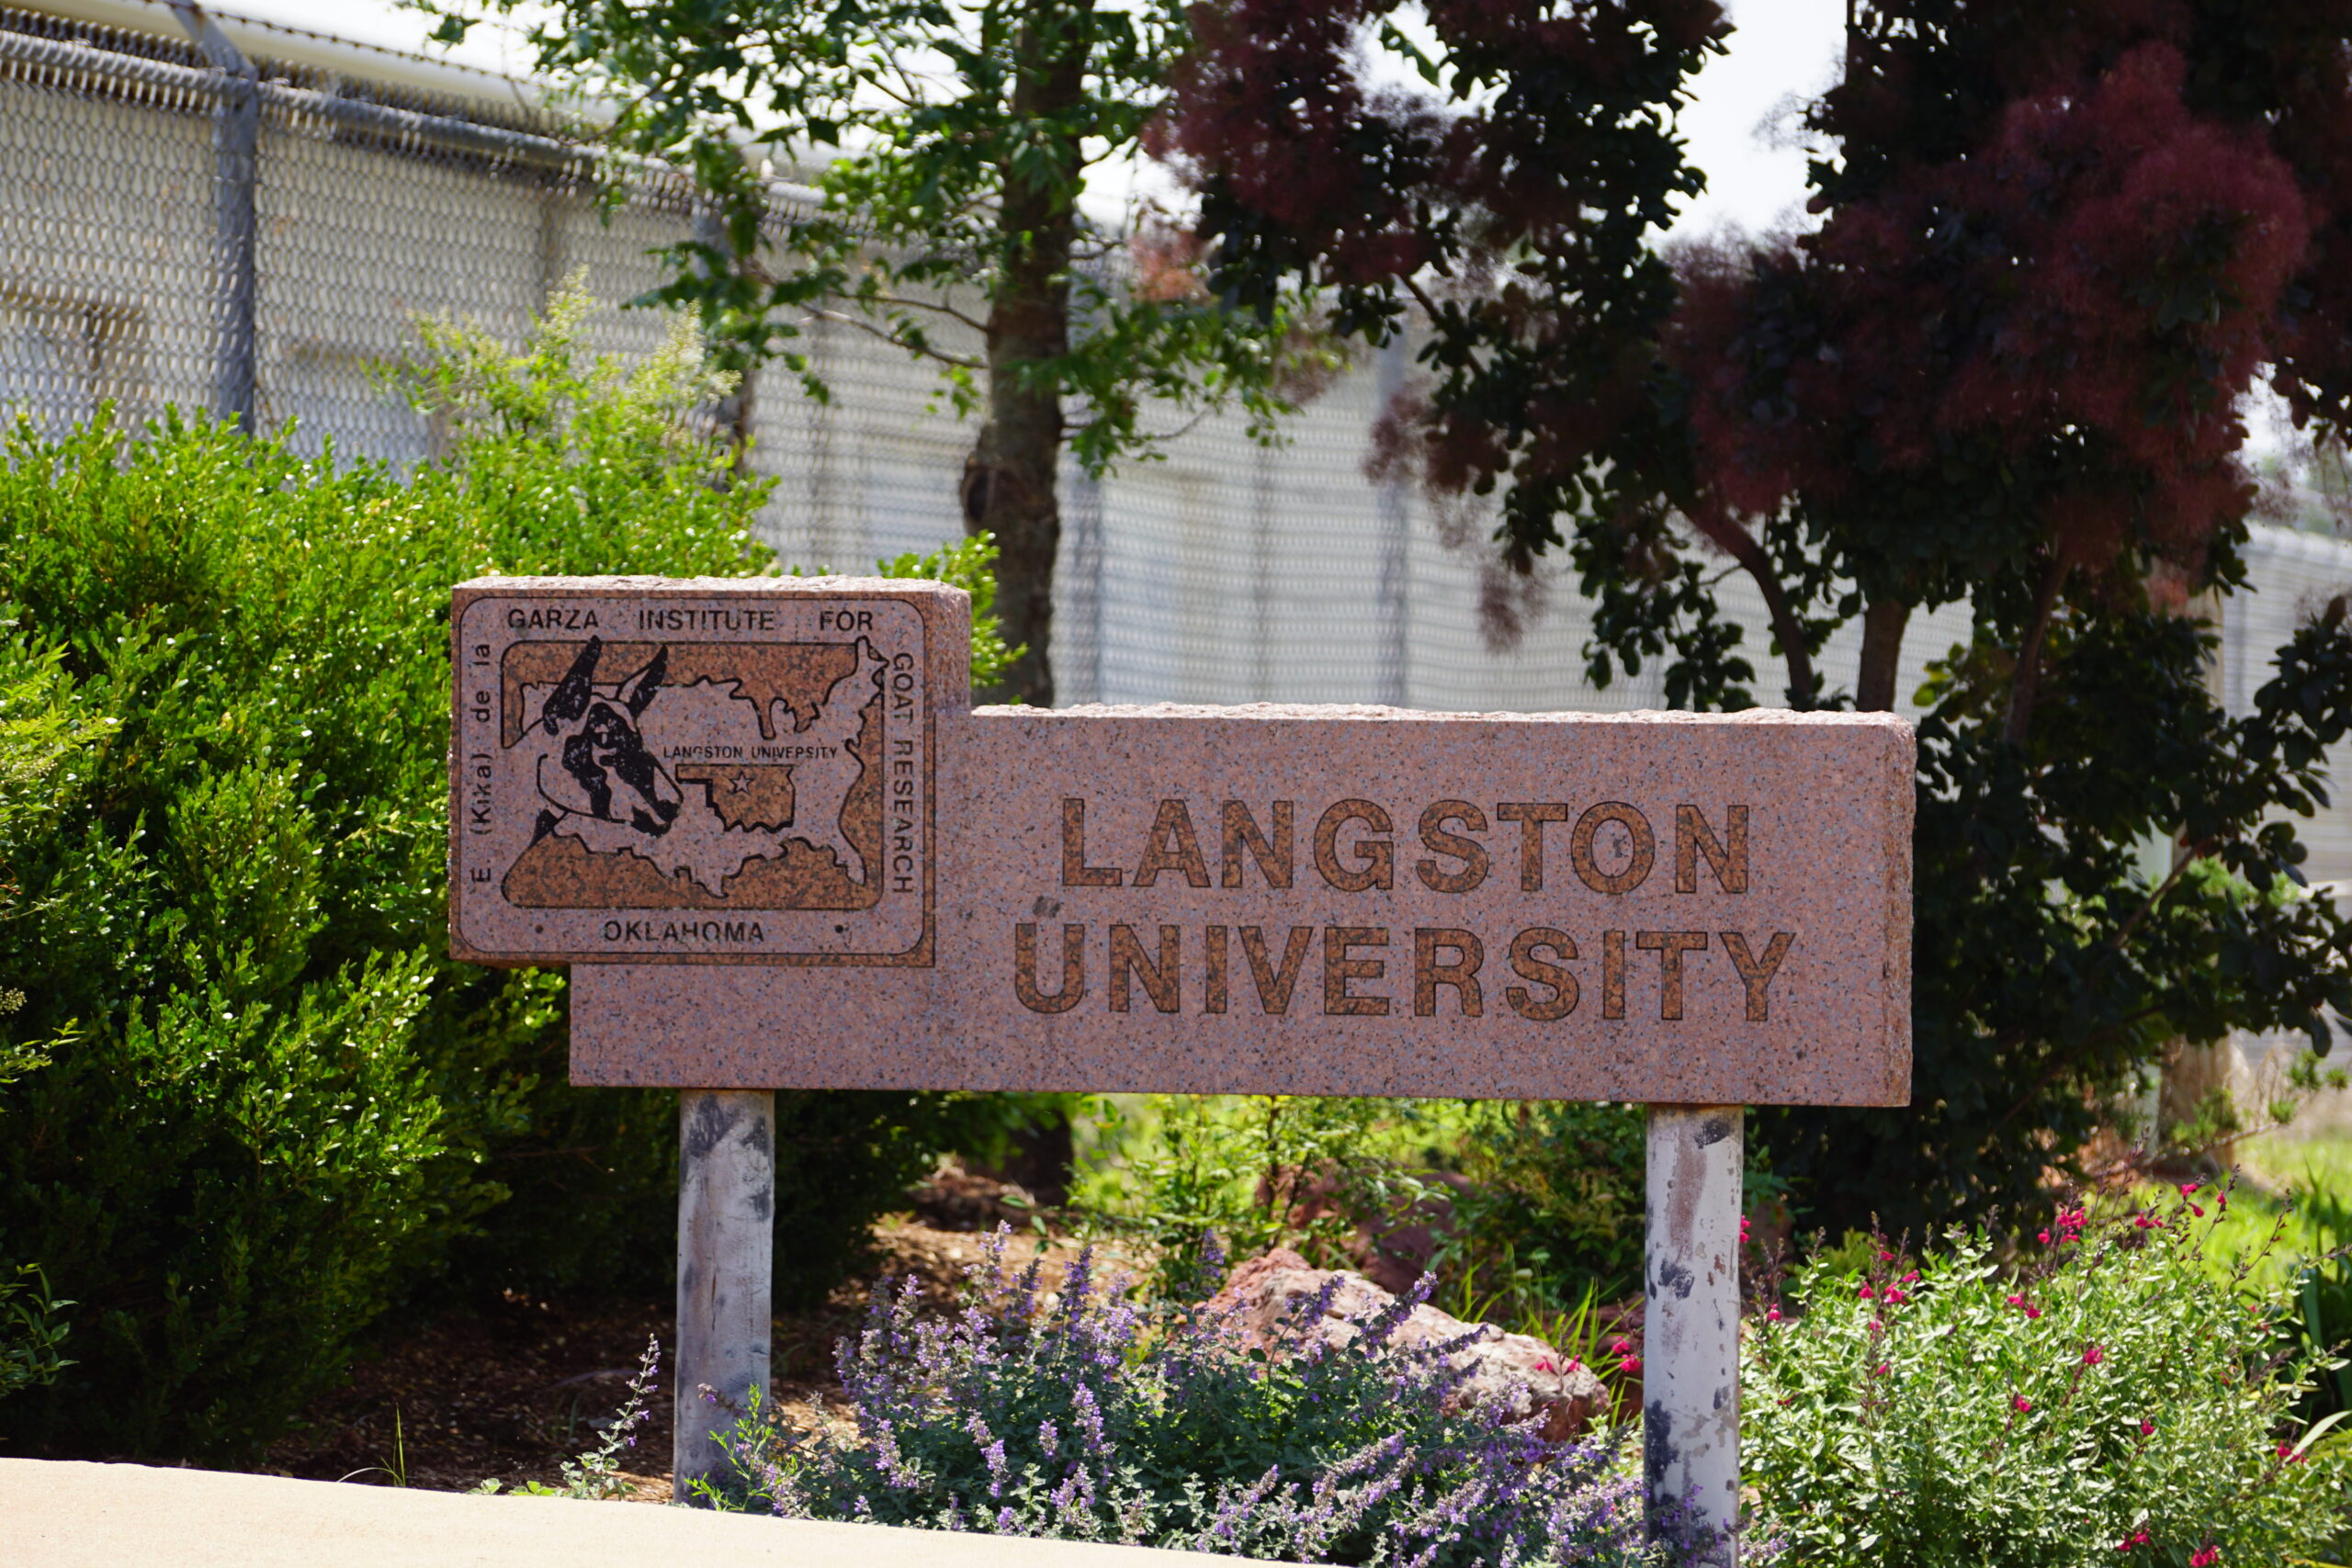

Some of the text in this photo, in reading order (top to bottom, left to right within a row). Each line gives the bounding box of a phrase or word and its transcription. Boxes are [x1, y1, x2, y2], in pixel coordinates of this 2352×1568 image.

[507, 609, 873, 632] GARZA INSTITUTE FOR
[471, 643, 491, 667] la
[469, 689, 491, 724] de
[470, 752, 492, 835] (Kika)
[892, 651, 913, 894] GOAT RESEARCH
[1062, 797, 1749, 895] LANGSTON
[603, 920, 764, 942] OKLAHOMA
[1014, 922, 1796, 1021] UNIVERSITY
